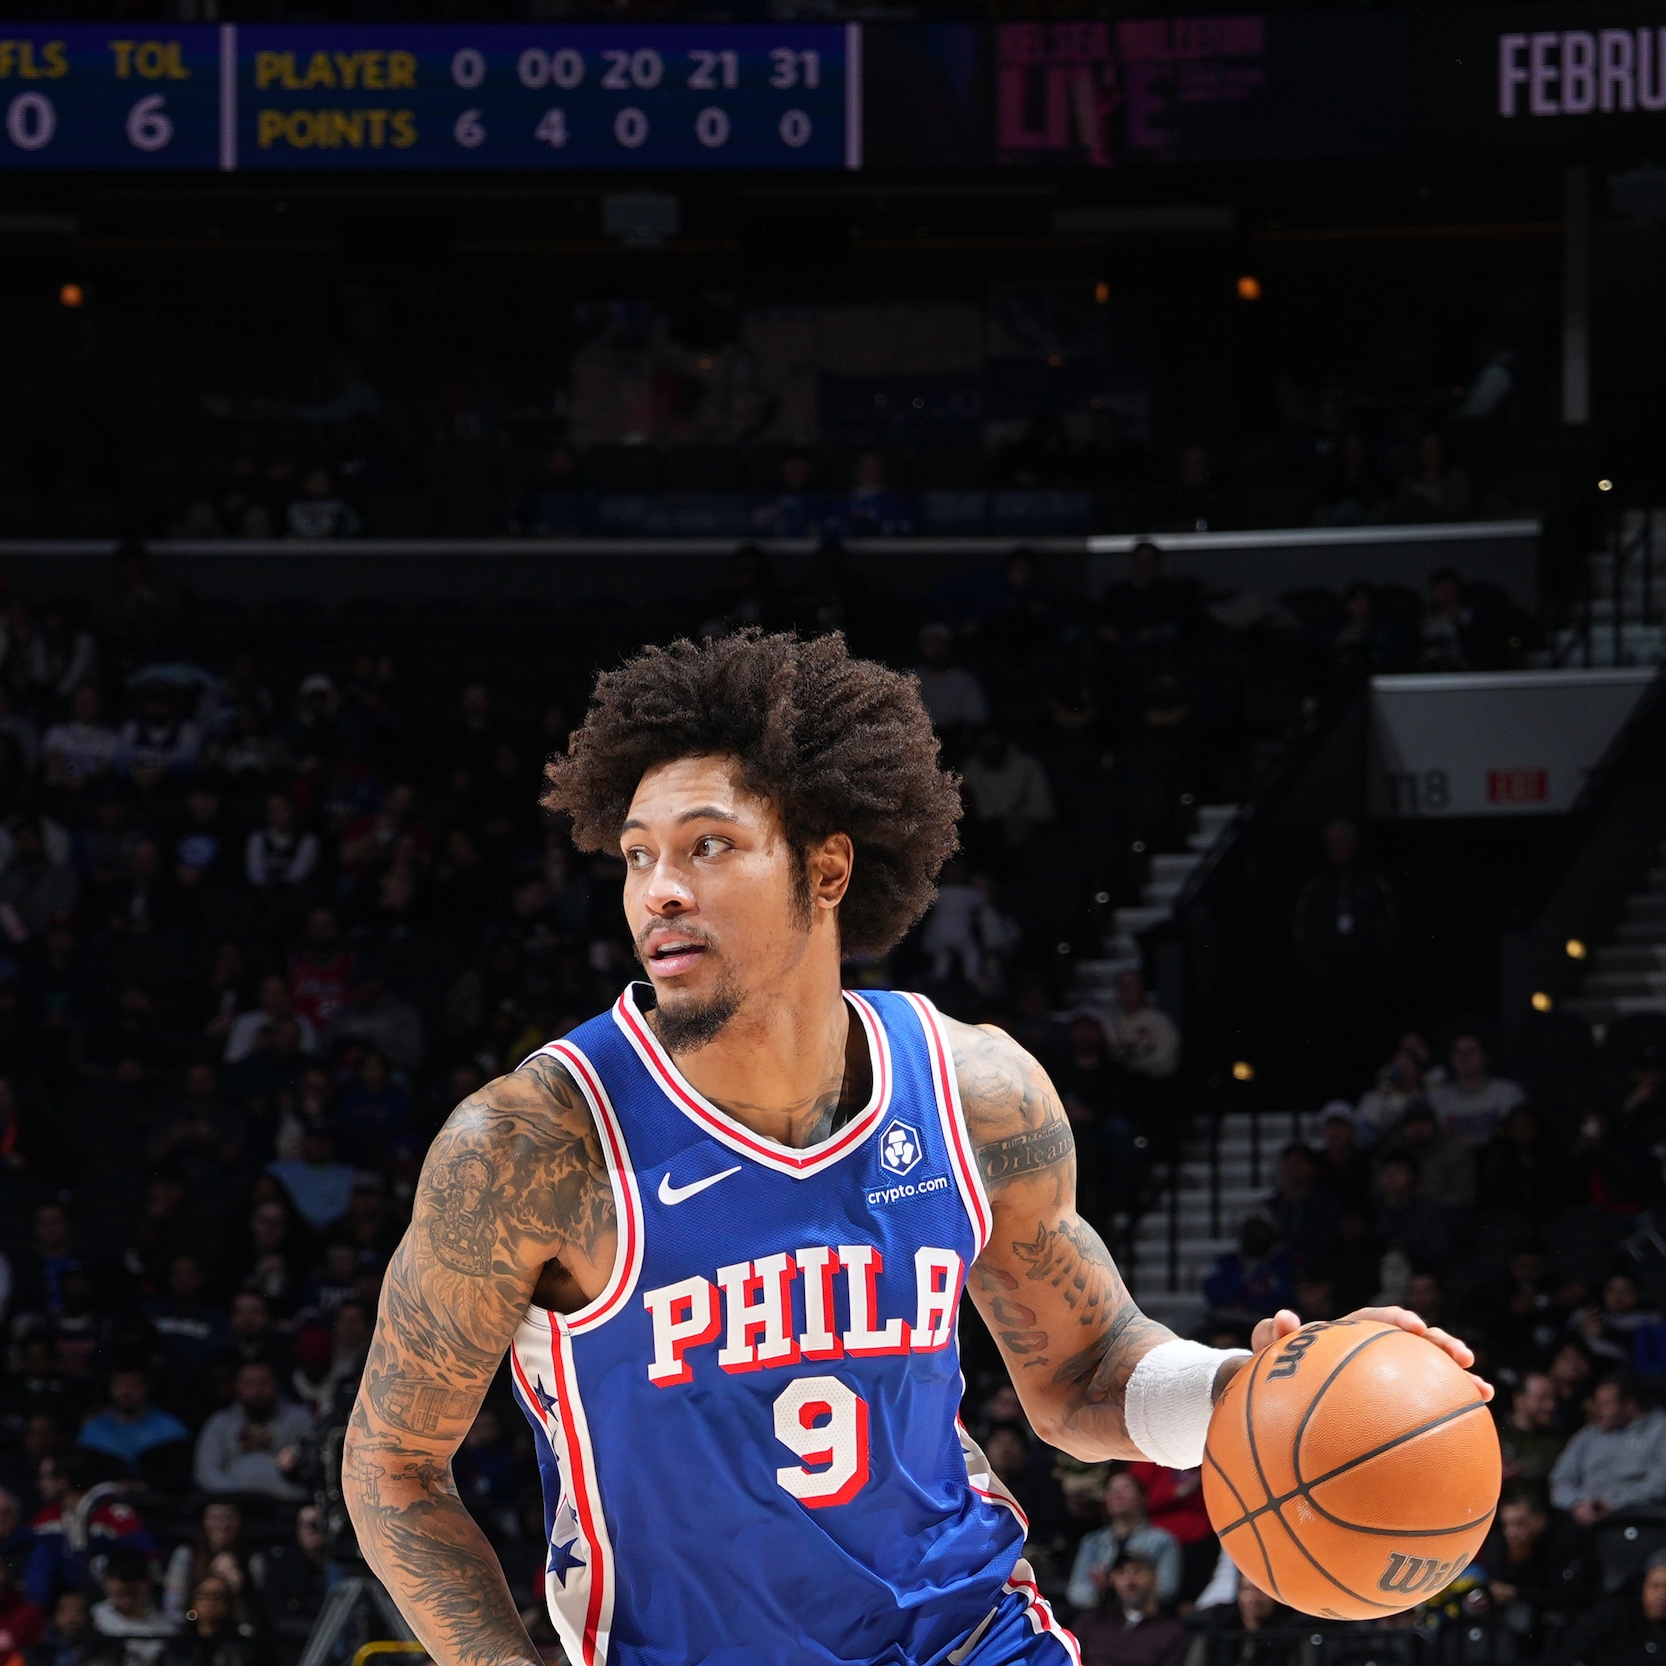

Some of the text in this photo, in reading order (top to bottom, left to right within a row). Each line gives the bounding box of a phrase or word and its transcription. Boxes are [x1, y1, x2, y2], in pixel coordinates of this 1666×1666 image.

[109, 40, 192, 81] TOL
[254, 46, 821, 91] PLAYER 0 00 20 21 31
[4, 90, 175, 152] 0 6
[256, 106, 814, 150] POINTS 6 4 0 0 0
[866, 1174, 950, 1207] crypto.com
[643, 1245, 966, 1389] PHILA
[772, 1376, 870, 1510] 9
